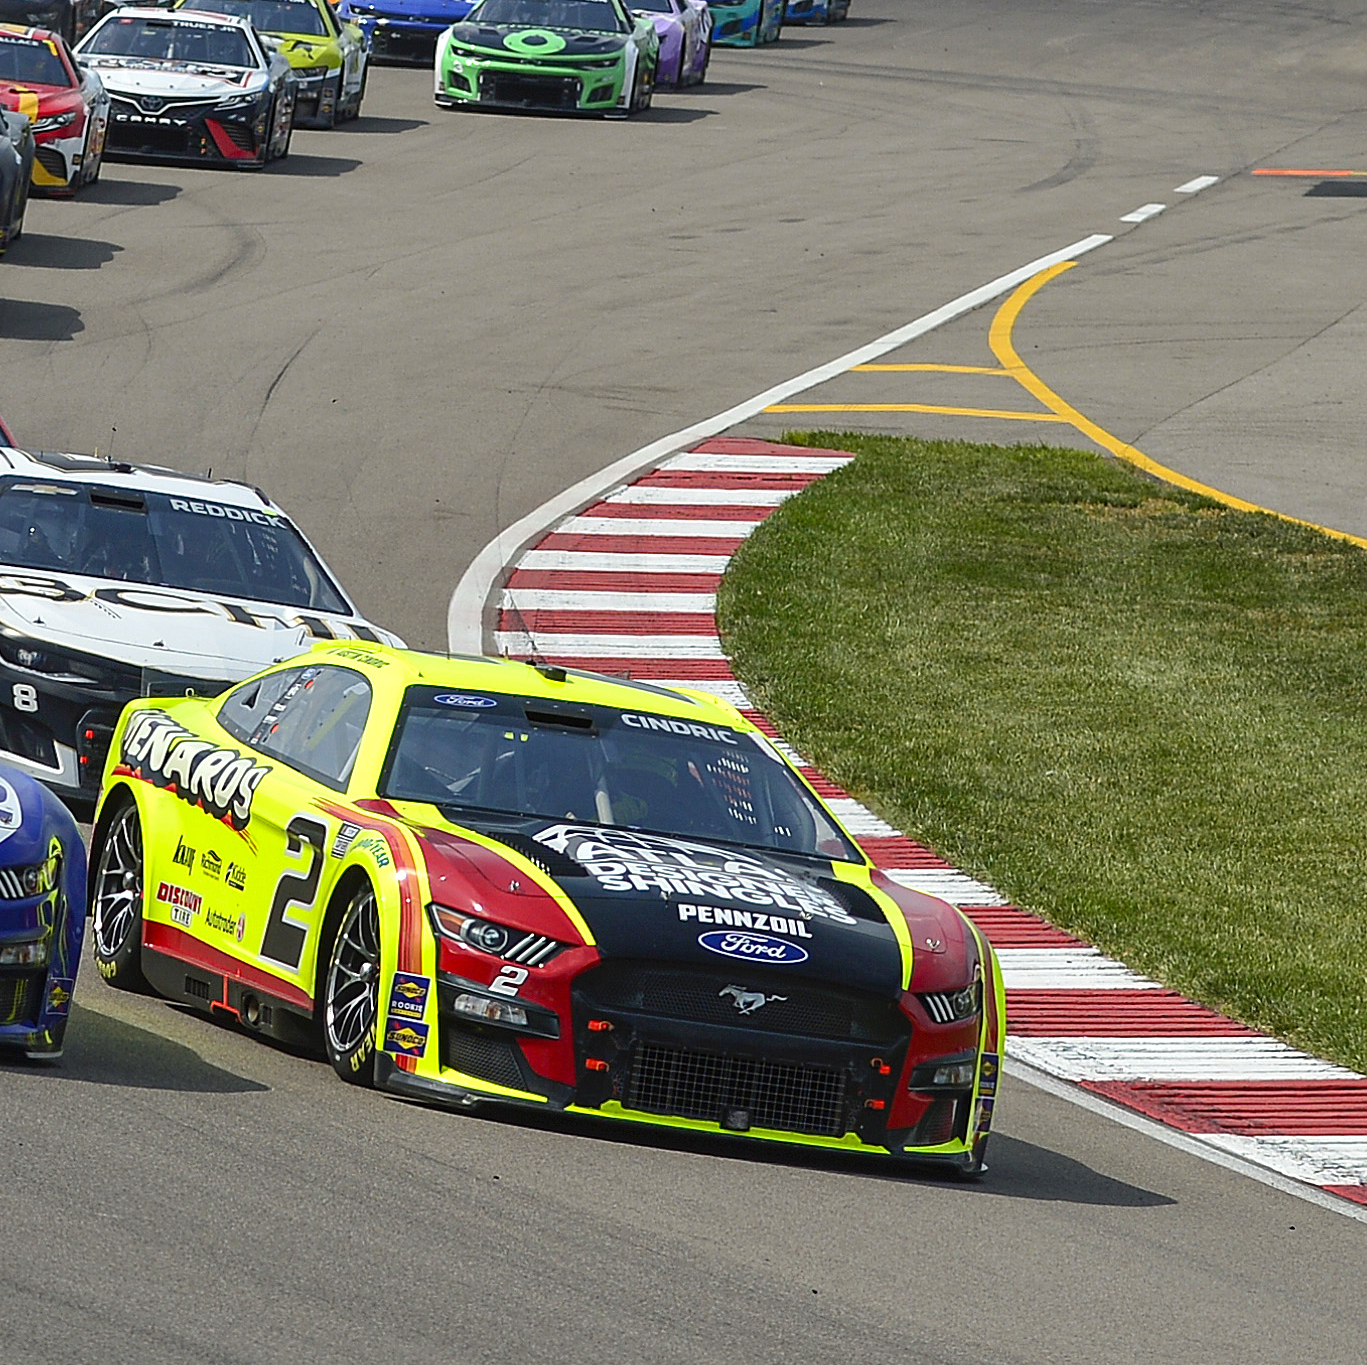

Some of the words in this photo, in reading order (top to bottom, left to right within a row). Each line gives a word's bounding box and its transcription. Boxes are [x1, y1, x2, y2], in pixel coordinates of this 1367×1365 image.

[169, 498, 287, 530] REDDICK
[12, 683, 38, 713] 8
[621, 712, 738, 746] CINDRIC
[122, 710, 273, 822] MENARDS
[258, 810, 330, 975] 2
[584, 862, 824, 898] DESIGNER
[157, 882, 202, 914] DISCOUNT
[596, 875, 858, 926] SHINGLES
[173, 907, 191, 925] TIRE
[678, 903, 813, 939] PENNZOIL
[395, 983, 426, 998] SUNOCO
[488, 965, 529, 997] 2
[391, 1000, 423, 1013] ROOKIE
[387, 1031, 426, 1051] SUNOCO
